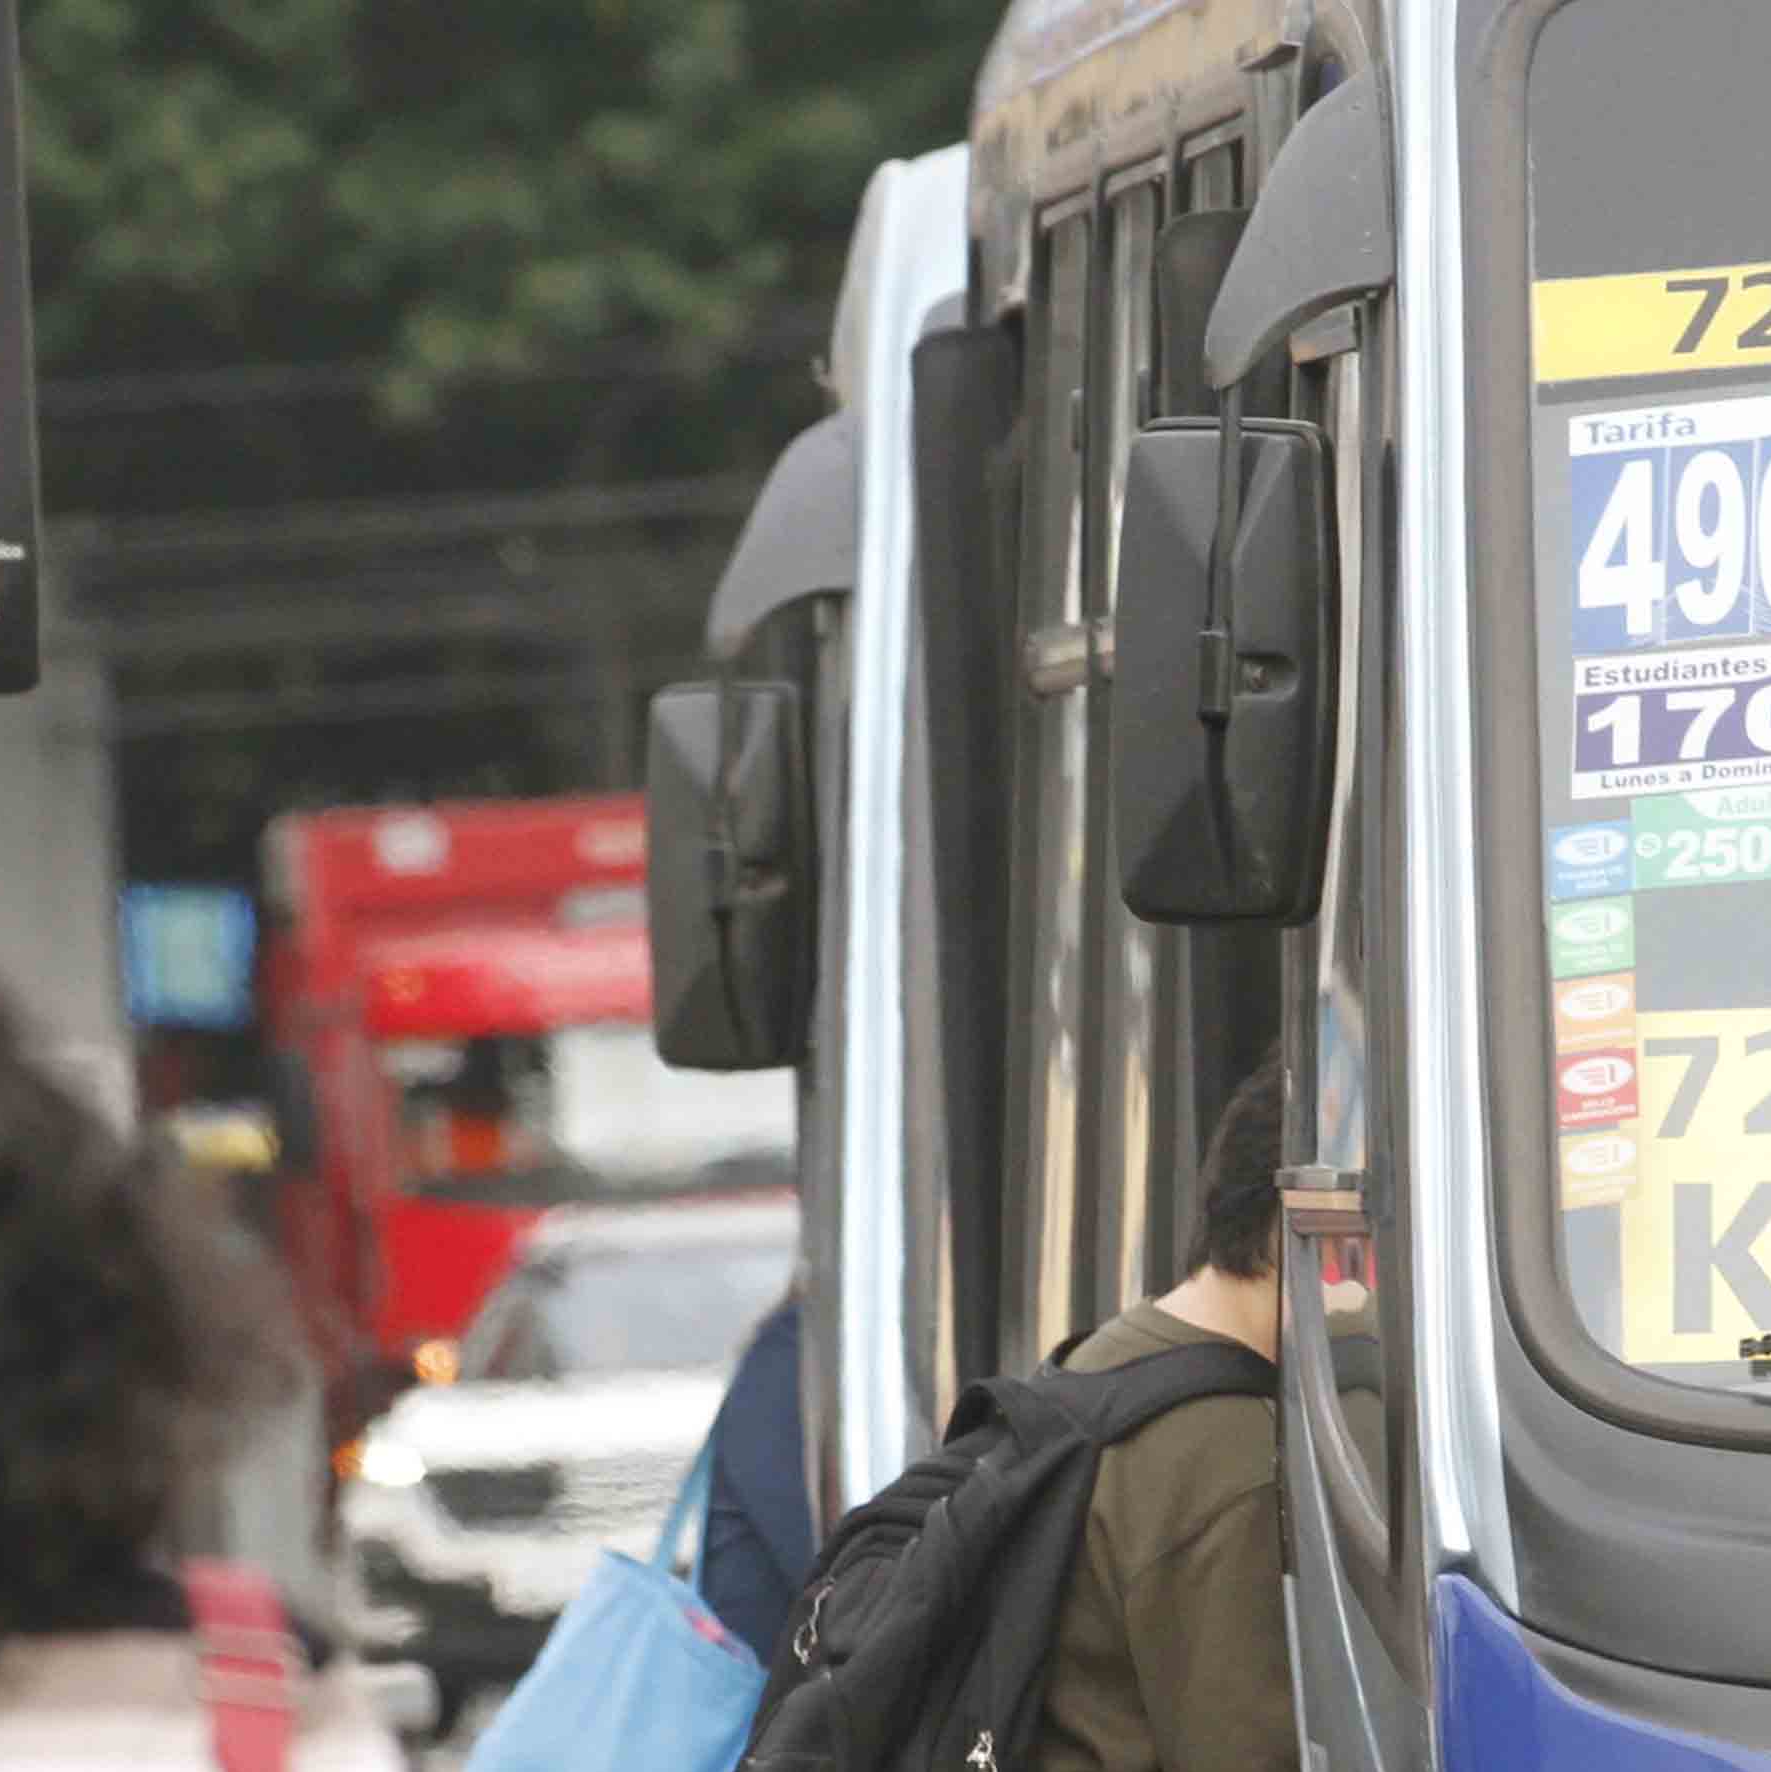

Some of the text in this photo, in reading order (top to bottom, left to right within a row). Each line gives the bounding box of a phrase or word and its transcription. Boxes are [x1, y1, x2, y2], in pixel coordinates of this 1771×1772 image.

[1584, 411, 1696, 446] Tarifa
[1584, 655, 1768, 688] Estudiantes
[1600, 770, 1670, 790] Lunes
[1678, 769, 1693, 784] a
